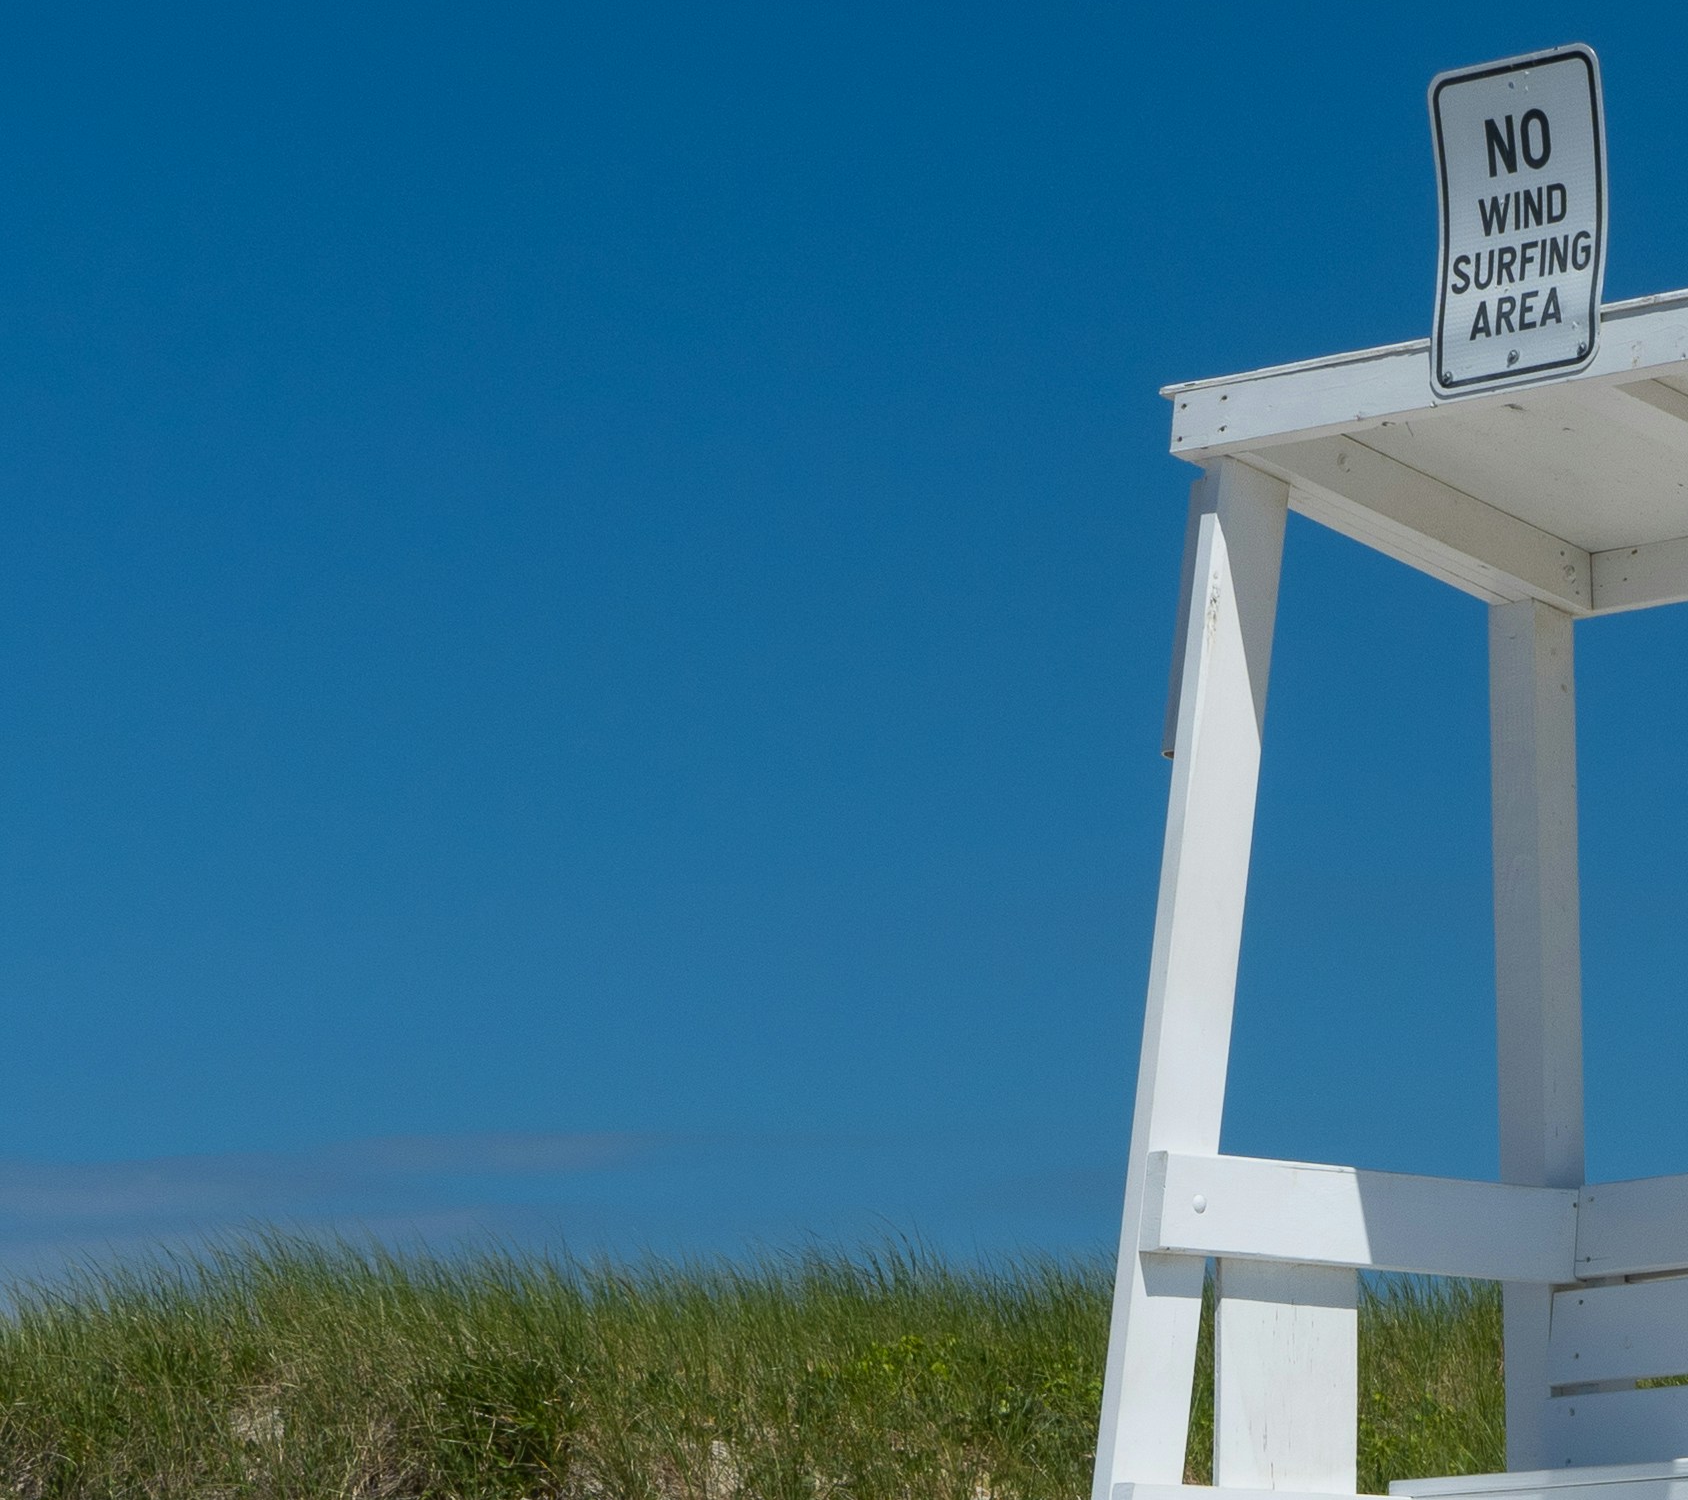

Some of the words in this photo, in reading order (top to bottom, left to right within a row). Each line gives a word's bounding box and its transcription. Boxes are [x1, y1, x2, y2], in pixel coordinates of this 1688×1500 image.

[1484, 108, 1551, 178] NO
[1478, 182, 1567, 237] WIND
[1451, 230, 1591, 295] SURFING
[1469, 286, 1562, 342] AREA
